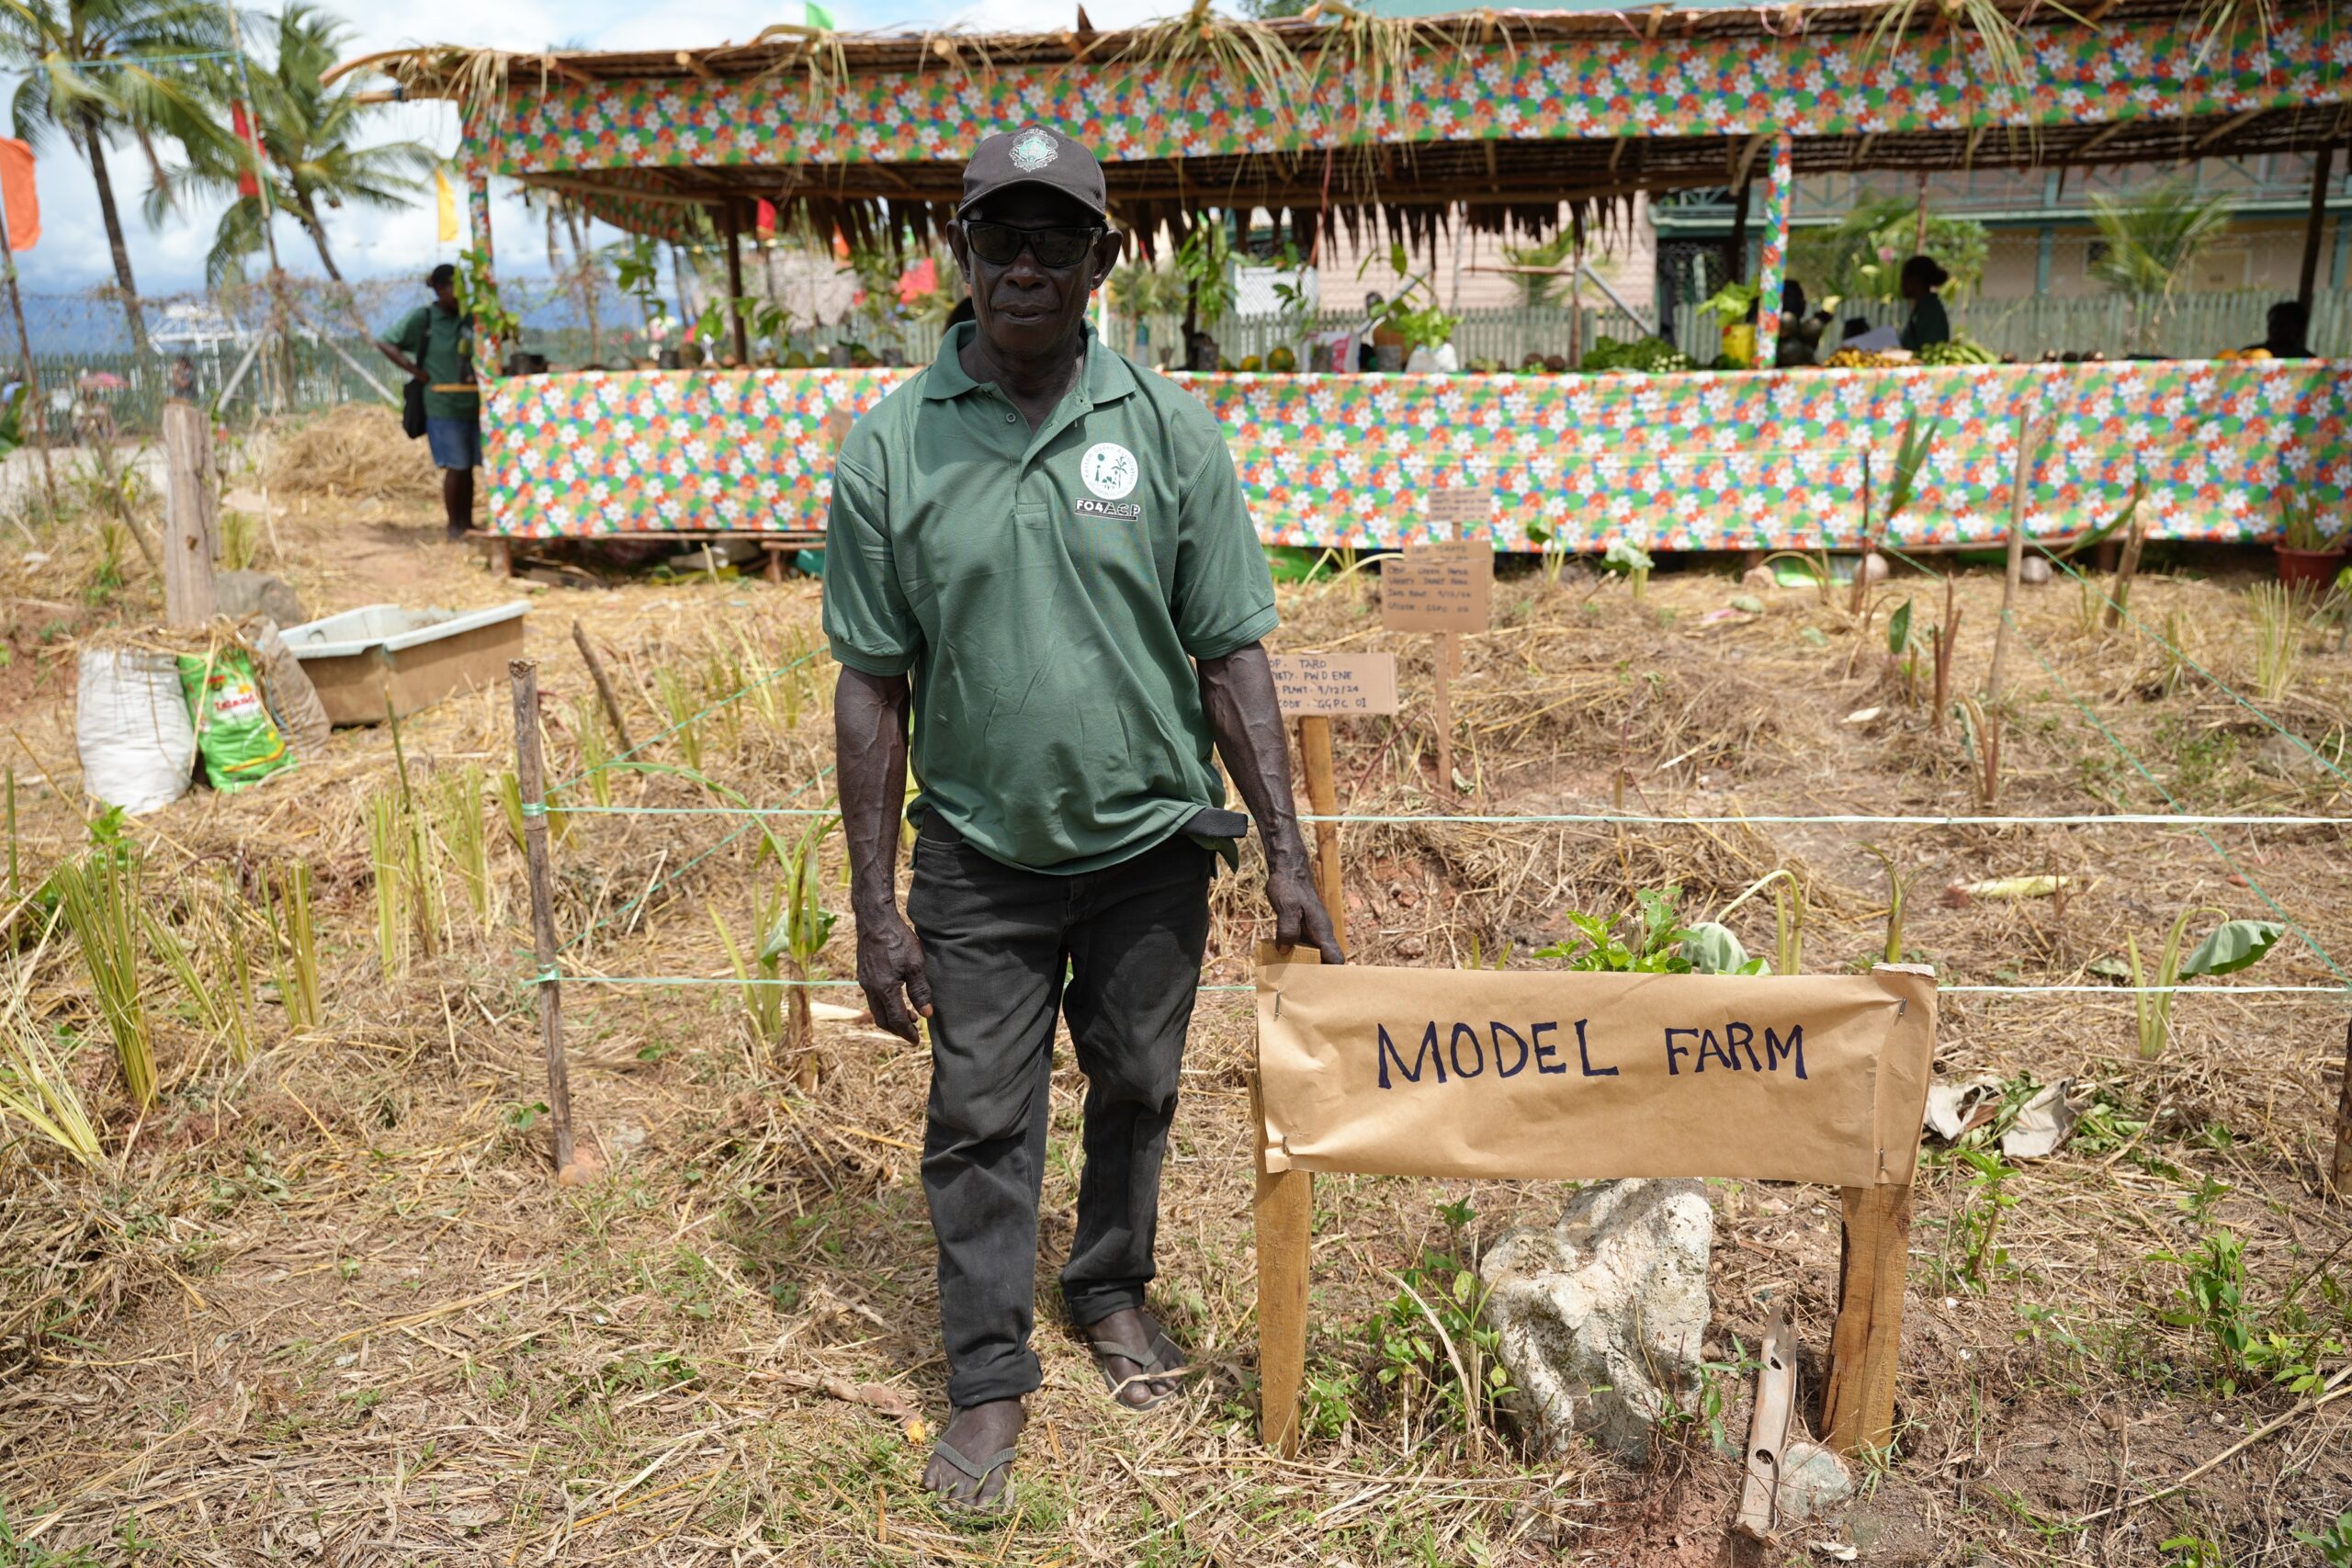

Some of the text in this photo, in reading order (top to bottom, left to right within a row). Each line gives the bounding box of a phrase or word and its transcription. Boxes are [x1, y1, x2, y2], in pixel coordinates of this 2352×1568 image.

[1076, 499, 1141, 517] FO4ACP
[1299, 659, 1328, 669] TARO
[1378, 1019, 1808, 1089] MODEL FARM
